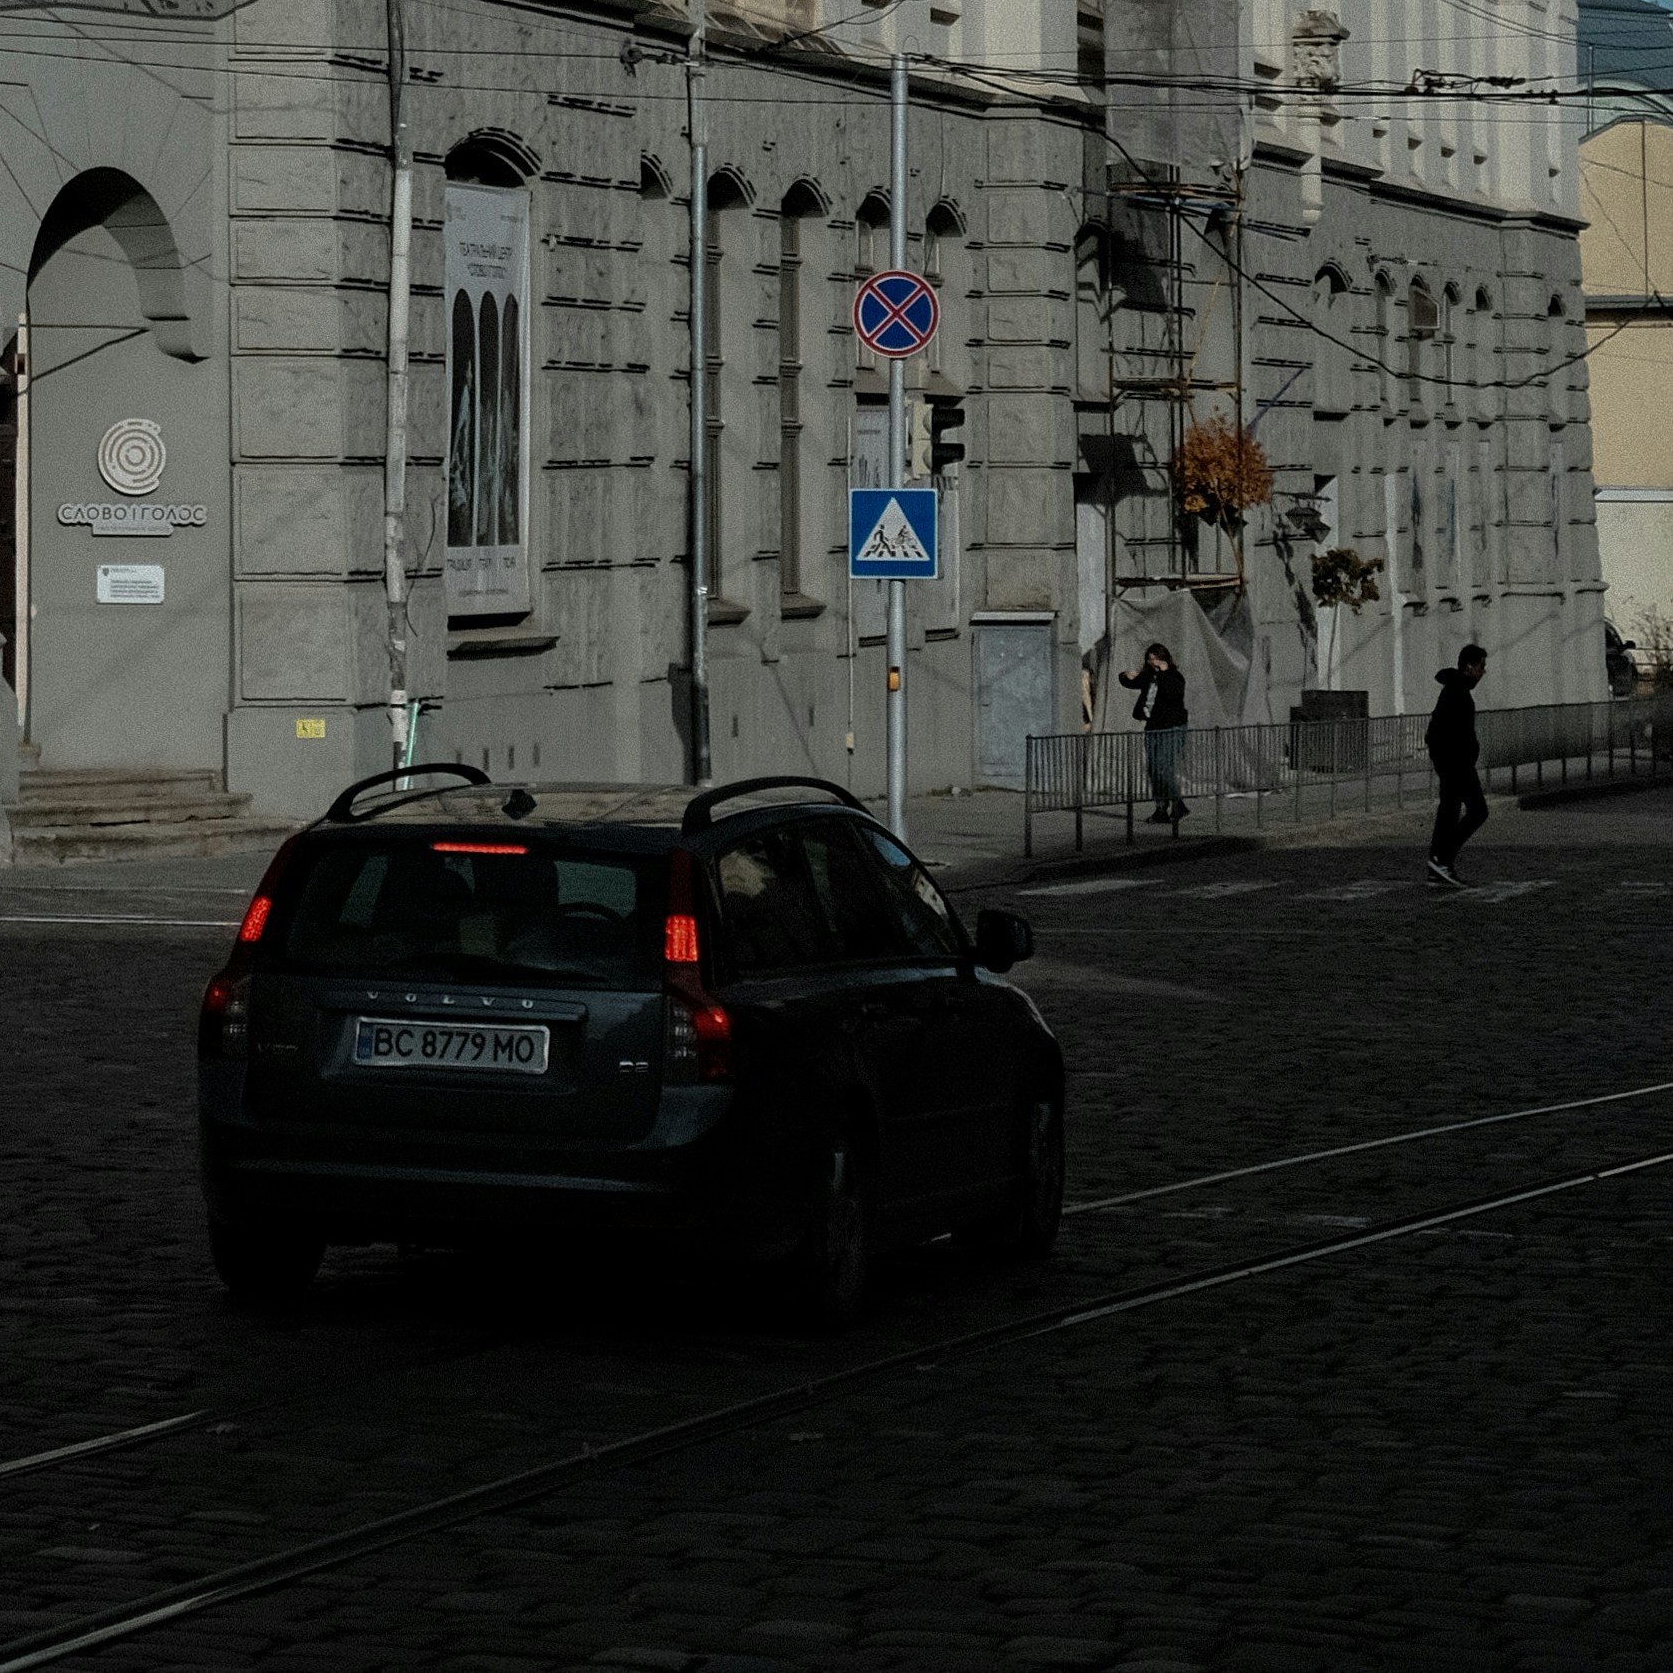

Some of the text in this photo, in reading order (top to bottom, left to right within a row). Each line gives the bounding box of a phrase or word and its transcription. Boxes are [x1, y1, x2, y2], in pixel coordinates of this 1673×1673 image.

[61, 506, 127, 520] СЛОВО
[141, 507, 206, 521] ГОЛОС
[367, 990, 534, 1009] VOLVO
[374, 1028, 534, 1063] BC 8779 MO
